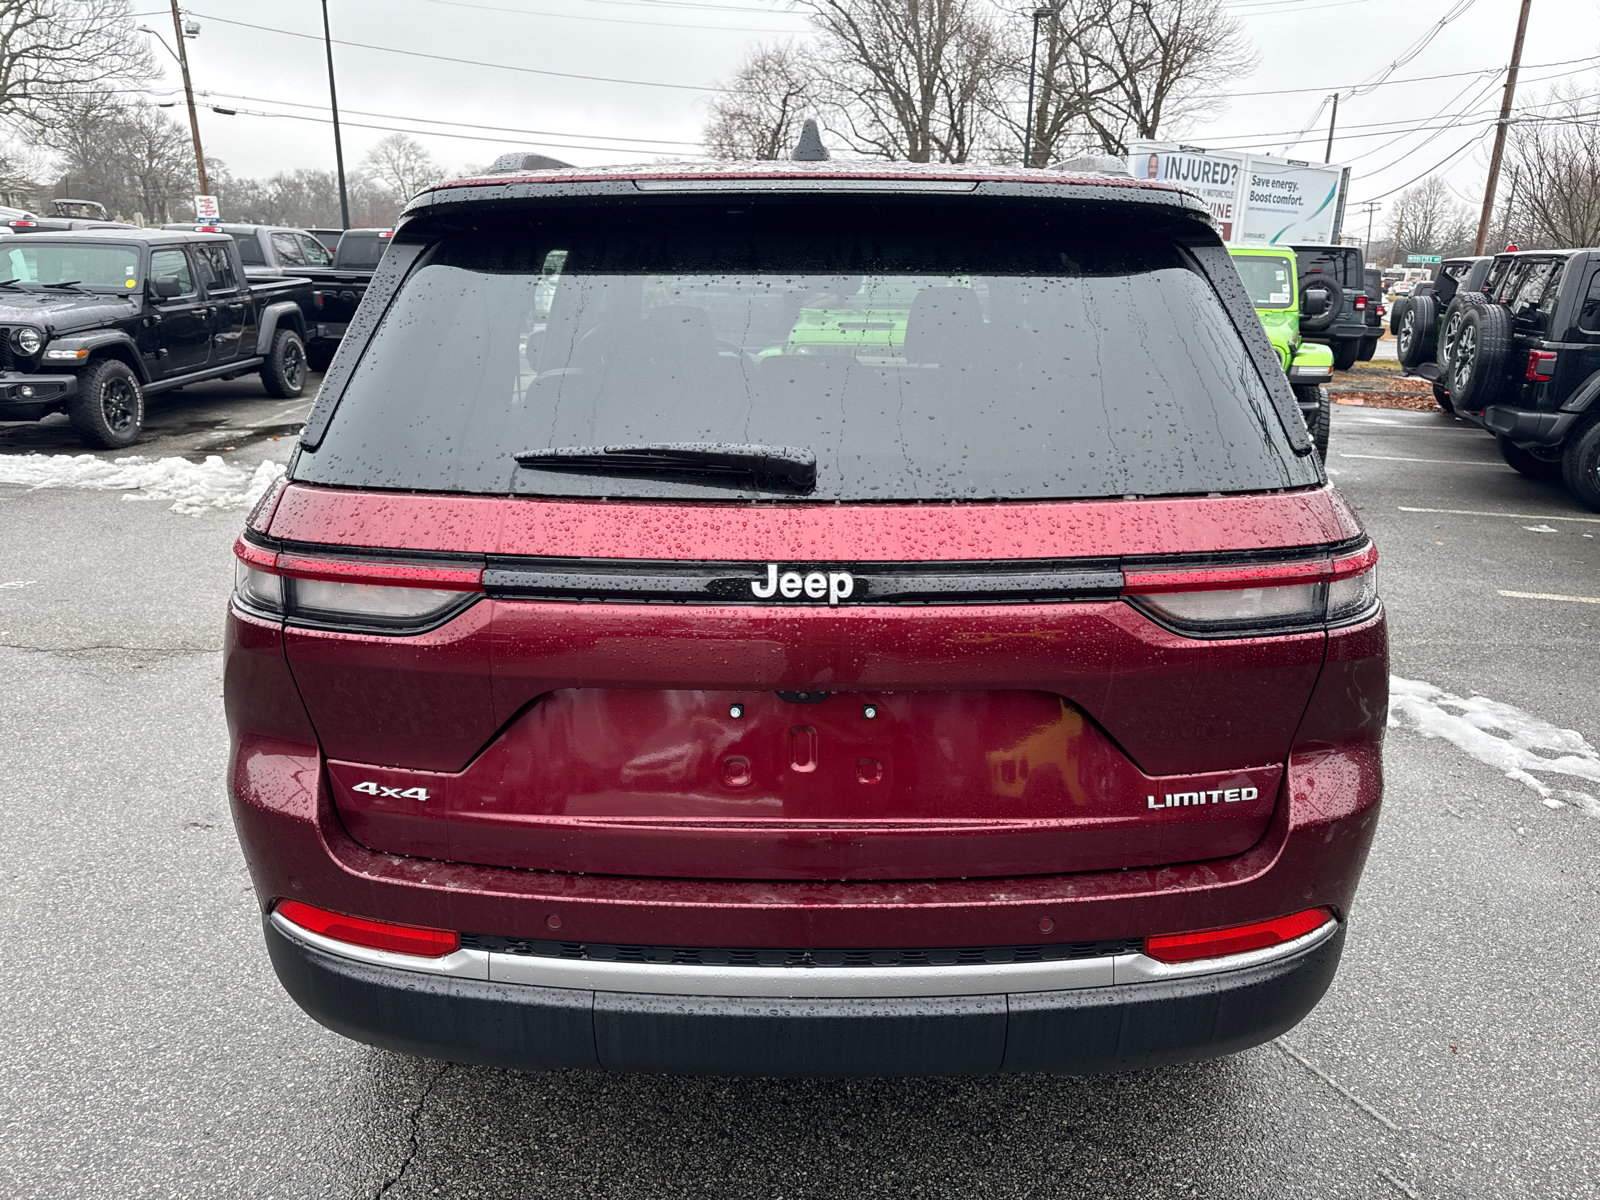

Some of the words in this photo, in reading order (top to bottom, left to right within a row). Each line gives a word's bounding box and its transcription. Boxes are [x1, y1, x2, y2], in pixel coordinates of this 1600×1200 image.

[1164, 156, 1238, 186] INJURED?
[1251, 174, 1270, 188] Save
[1271, 179, 1299, 193] energy.
[1250, 190, 1272, 204] Boost
[1272, 194, 1304, 206] comfort.
[751, 564, 854, 605] Jeep
[352, 781, 431, 802] 4x4
[1147, 787, 1258, 809] LIMITED
